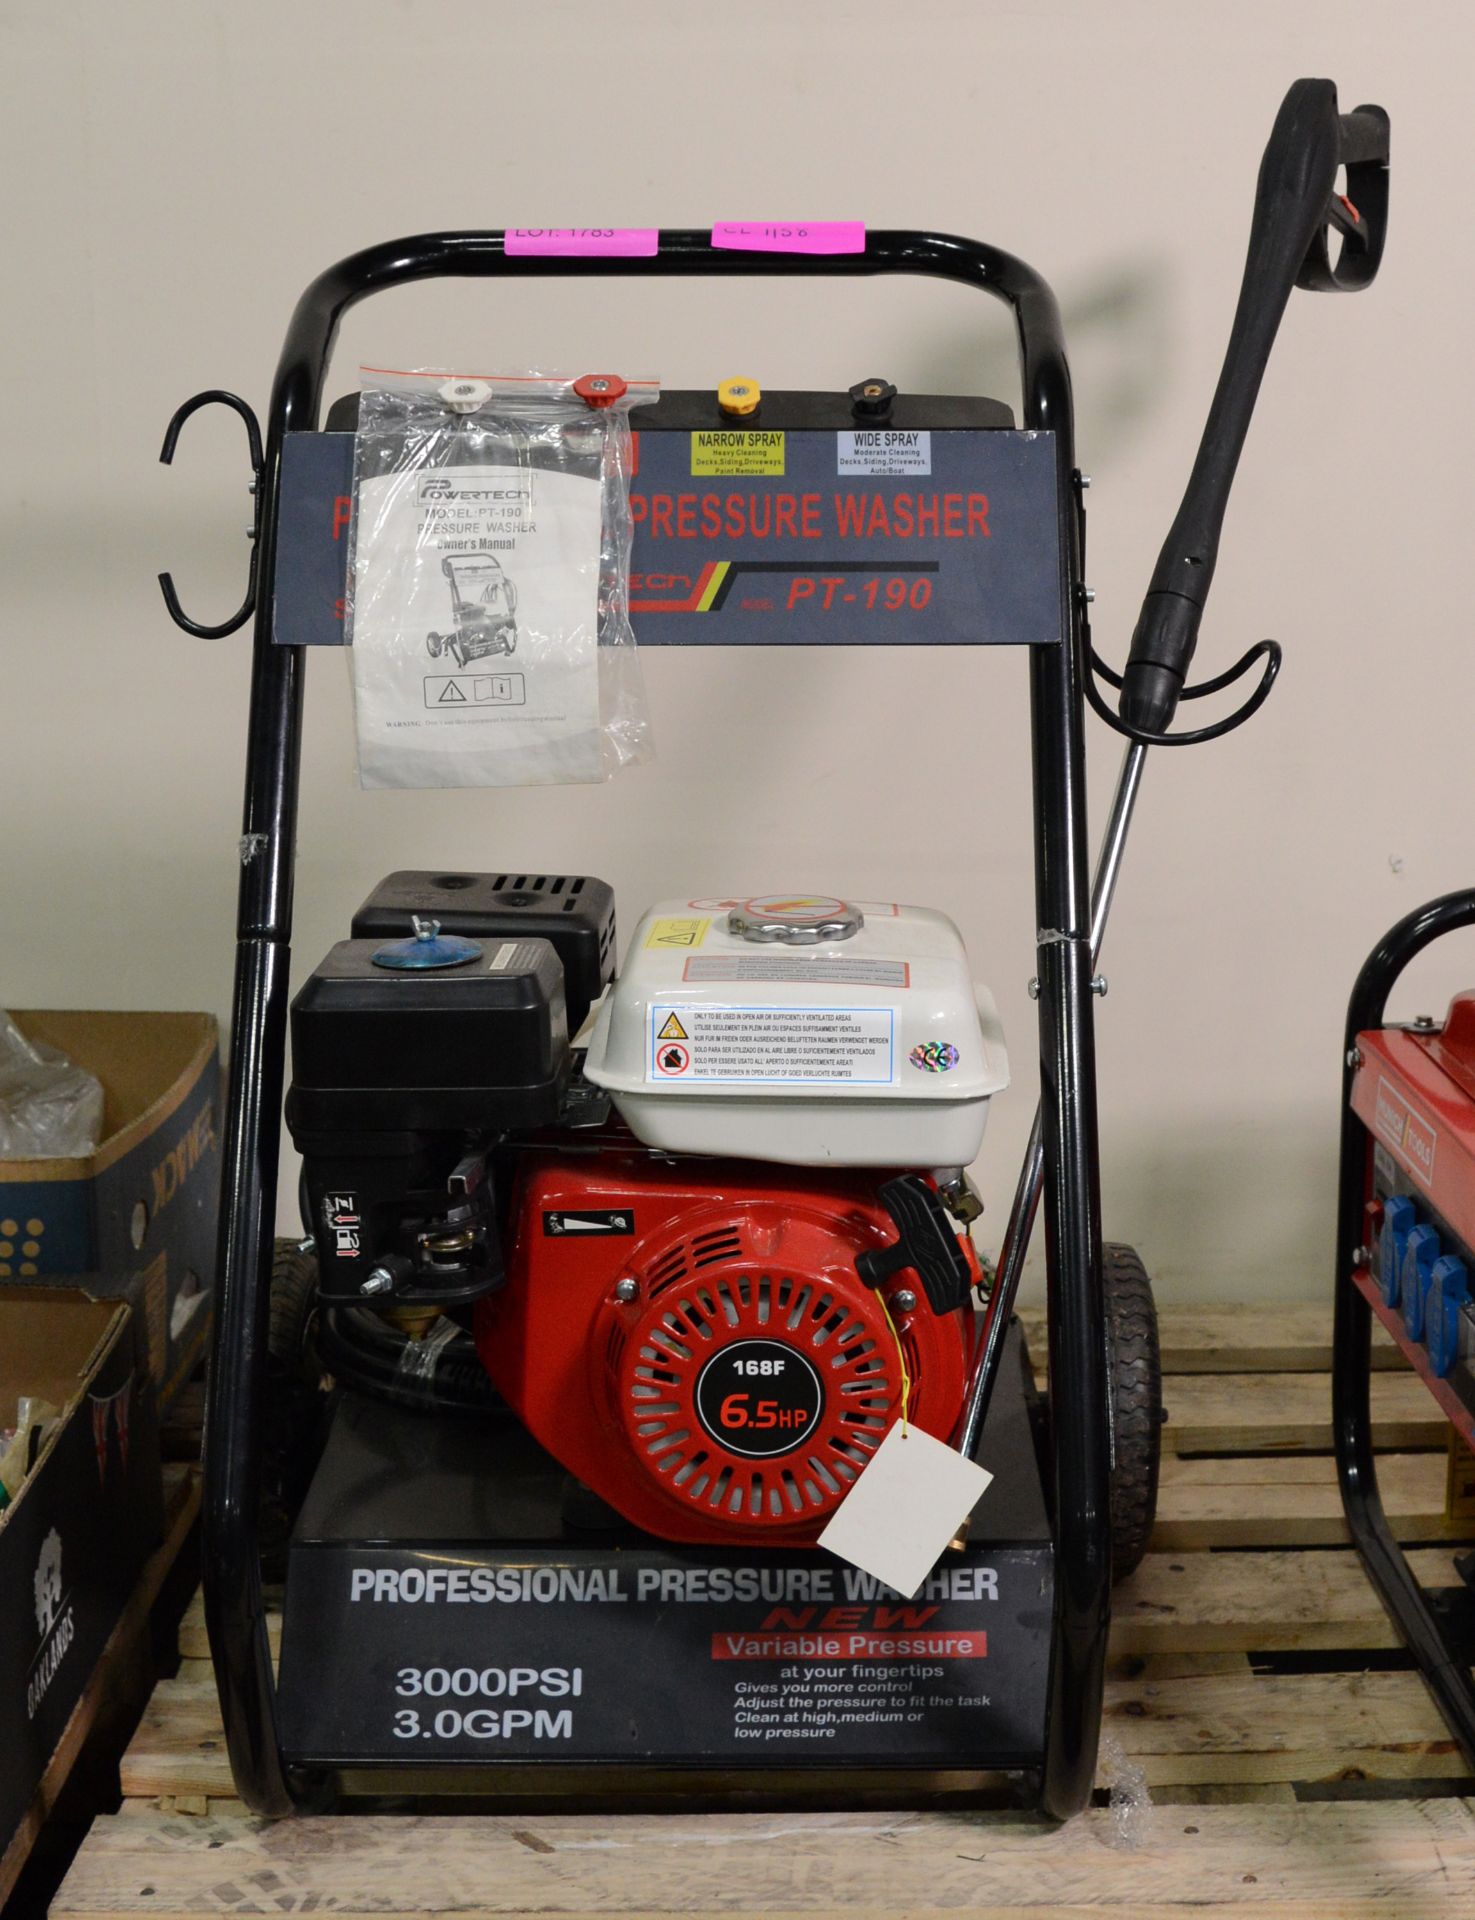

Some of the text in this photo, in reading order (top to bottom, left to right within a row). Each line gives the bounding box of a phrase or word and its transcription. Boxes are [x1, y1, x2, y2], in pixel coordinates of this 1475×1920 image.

[698, 433, 783, 447] NARROW SPRAY
[854, 433, 919, 446] WIDE SPRAY
[713, 449, 767, 457] Heavy Cleaning
[889, 449, 920, 457] Cleaning
[870, 467, 905, 475] Auto/Boat
[629, 493, 992, 538] PRESSURE WASHER
[417, 521, 537, 534] PRESSURE WASHER
[479, 537, 515, 550] Manual
[786, 577, 933, 611] PT-190
[733, 1360, 785, 1376] 168F
[350, 1567, 999, 1603] PROFESSIONAL PRESSURE WAHER
[760, 1606, 942, 1630] NEW
[726, 1636, 973, 1656] Variable Pressure
[27, 1605, 75, 1720] OAKLANDS
[780, 1664, 945, 1681] at your fingertips
[395, 1667, 583, 1697] 3000PSI
[734, 1681, 913, 1696] Gives you more control
[734, 1695, 991, 1710] Adjust the pressure to fit the task
[393, 1709, 573, 1739] 3.0GPM
[734, 1711, 925, 1726] Clean at high,medium or
[734, 1727, 836, 1740] low pressure
